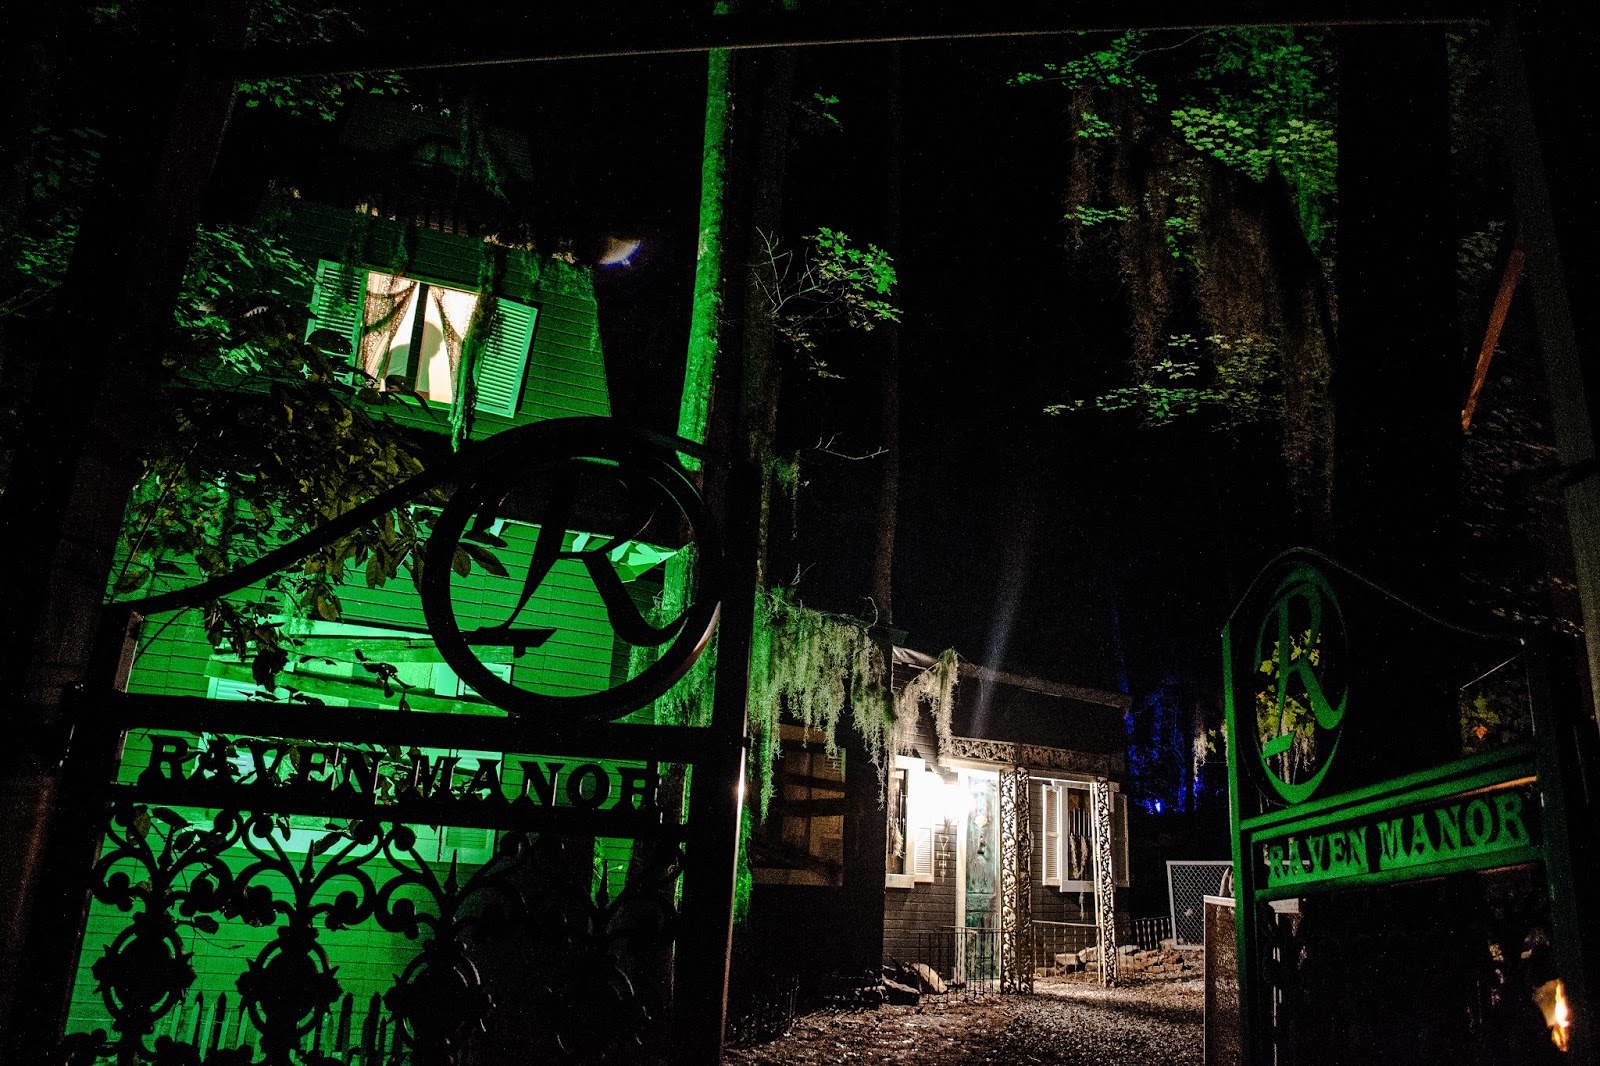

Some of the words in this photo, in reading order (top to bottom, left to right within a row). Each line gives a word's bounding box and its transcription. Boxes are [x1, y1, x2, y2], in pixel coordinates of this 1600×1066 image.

[1260, 580, 1348, 758] R
[139, 735, 388, 800] RAVEN
[1268, 826, 1369, 884] RAVEN
[1376, 792, 1530, 868] MANOR
